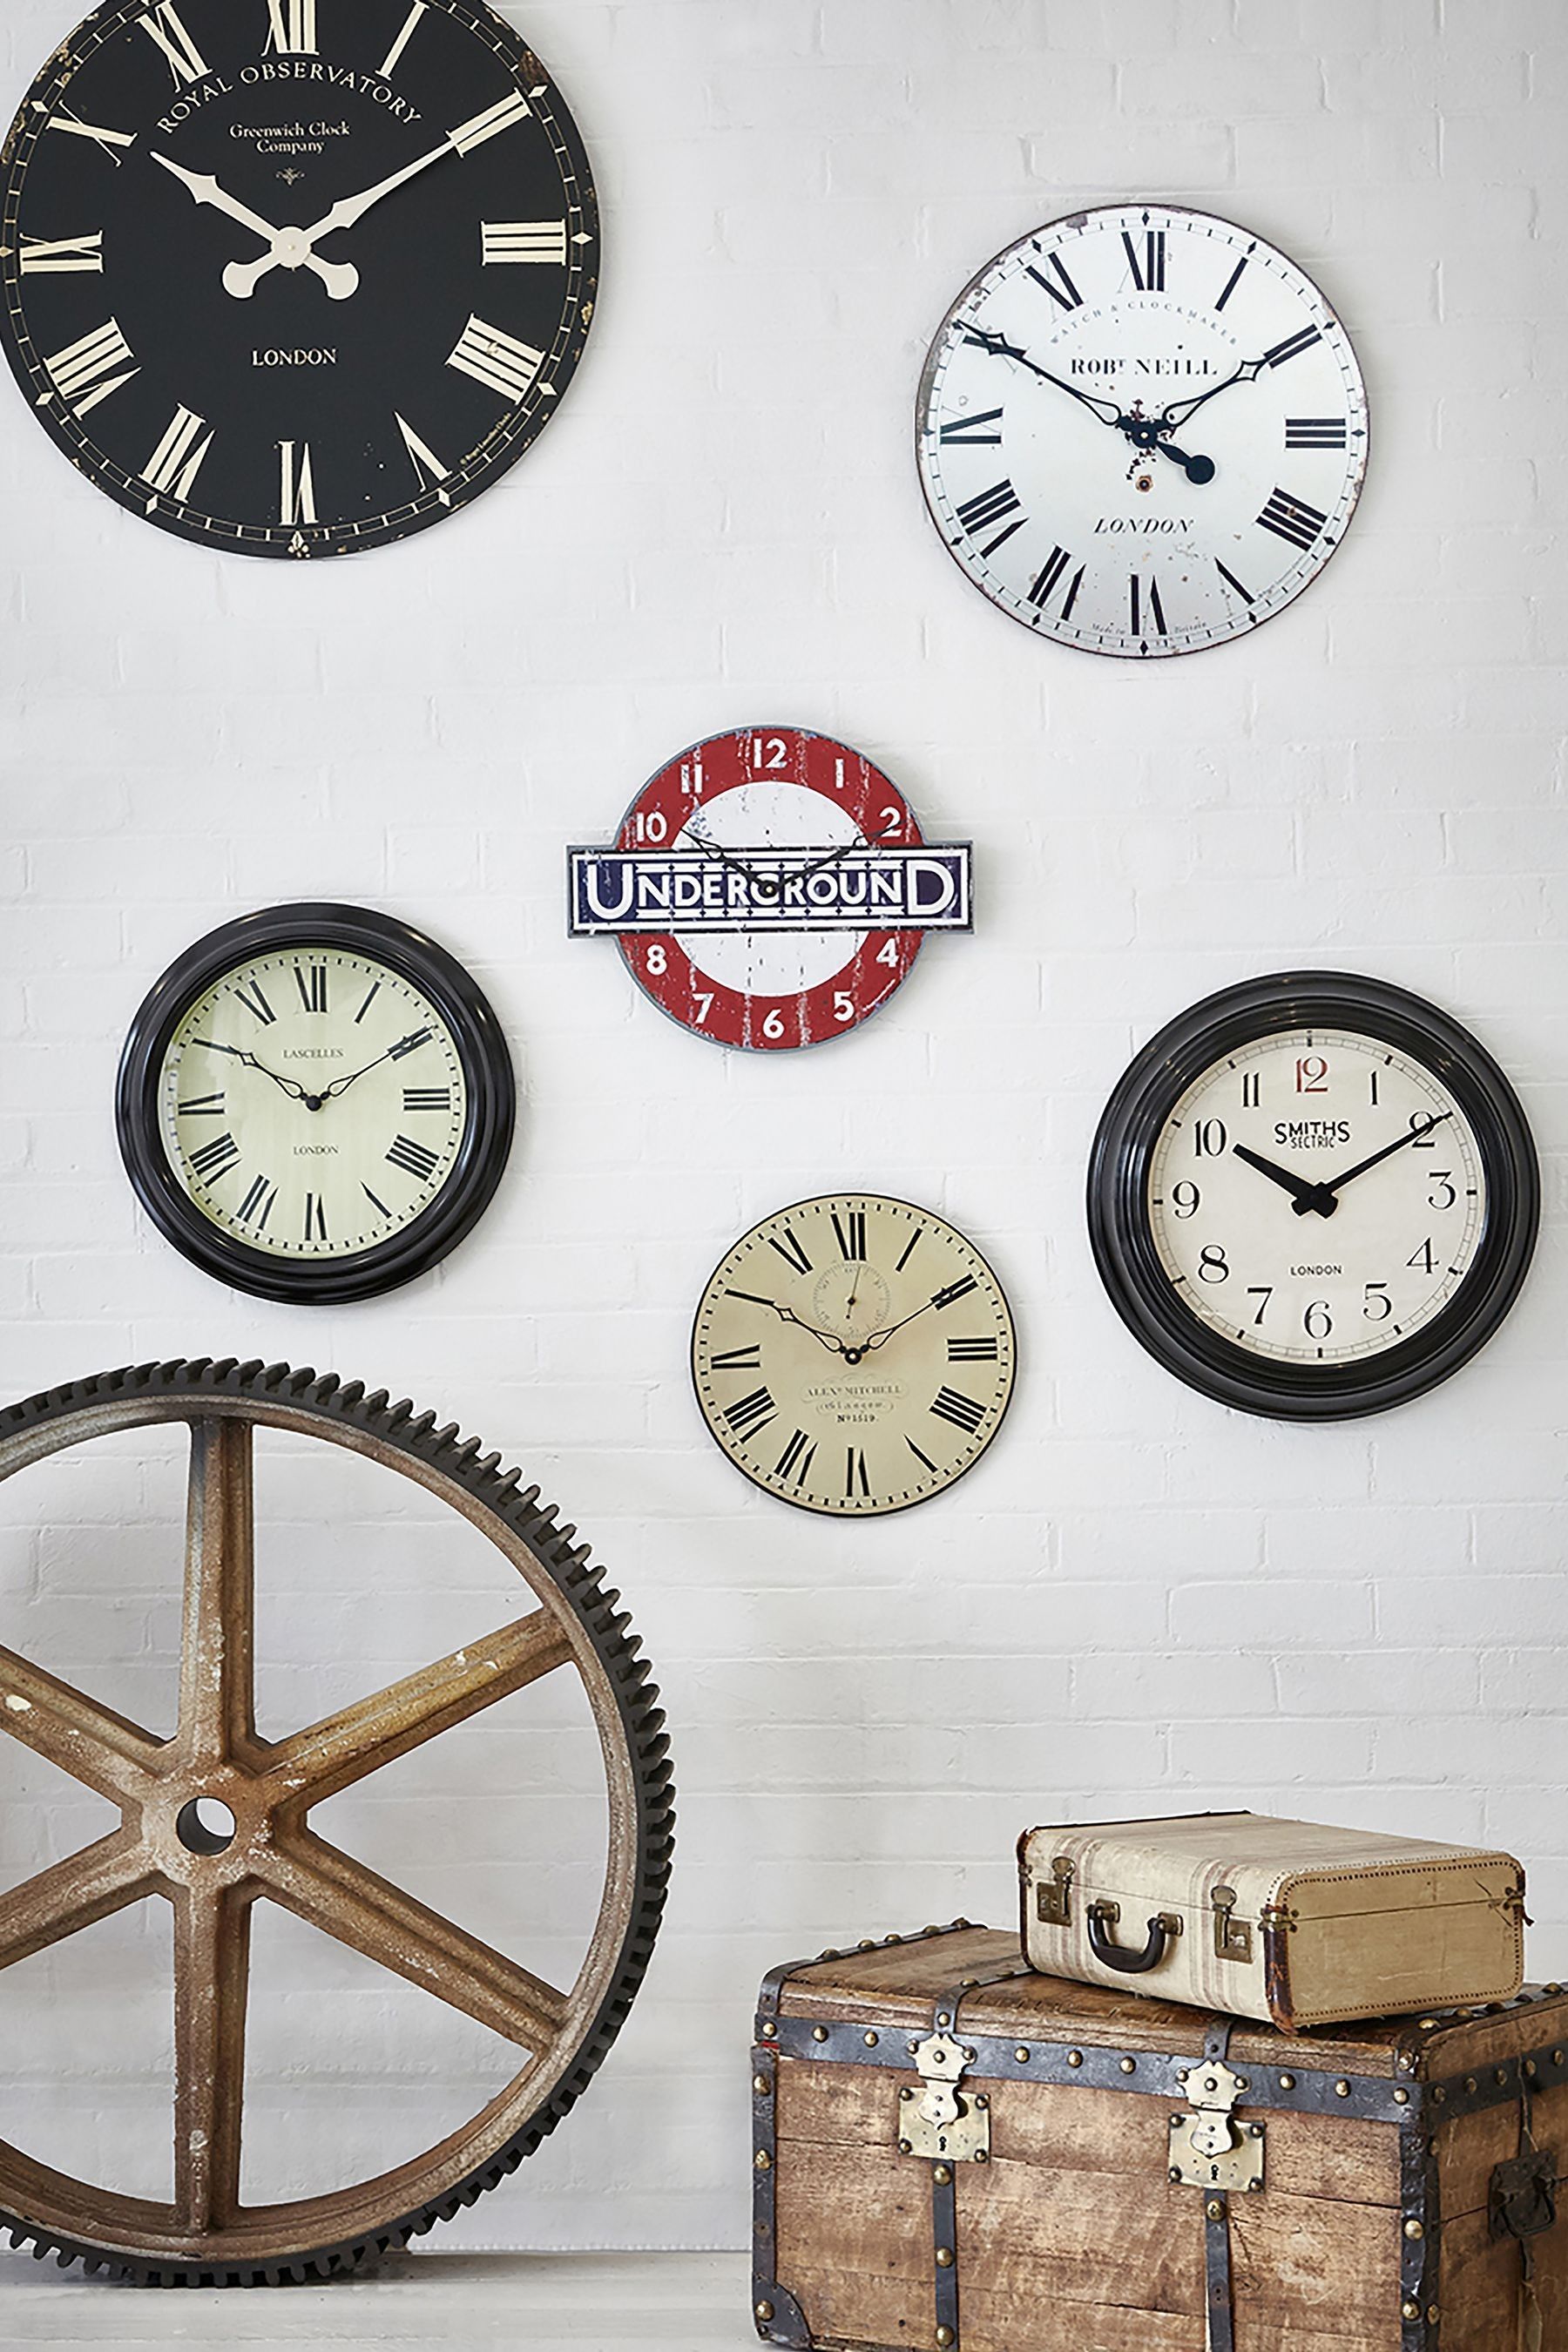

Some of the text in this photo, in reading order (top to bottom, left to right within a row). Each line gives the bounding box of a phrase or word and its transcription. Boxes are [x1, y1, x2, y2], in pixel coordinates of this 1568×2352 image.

[135, 0, 212, 91] XI
[157, 62, 422, 133] ROYAL OBSERVATORY
[45, 101, 138, 166] X
[229, 121, 350, 139] Greenwich Clock
[256, 139, 325, 155] Company
[19, 230, 103, 274] IX
[480, 220, 566, 265] III
[1119, 231, 1168, 294] XII
[1024, 250, 1085, 321] XI
[1214, 257, 1249, 311] I
[1128, 301, 1237, 346] CLOCKMAKER
[43, 316, 142, 420] VIII
[252, 348, 337, 366] LONDON
[445, 314, 544, 403] IIII
[1135, 359, 1217, 375] NEILL
[394, 411, 451, 491] V
[1285, 416, 1346, 449] III
[138, 403, 215, 503] VII
[279, 440, 318, 526] VI
[956, 478, 1029, 559] VIII
[1094, 518, 1194, 534] LONDON
[1254, 484, 1328, 551] IIII
[1026, 544, 1086, 620] VII
[1130, 574, 1167, 636] VI
[754, 740, 787, 768] 12
[681, 764, 702, 794] 11
[835, 760, 844, 787] 1
[636, 813, 667, 842] 10
[880, 808, 902, 836] 2
[587, 860, 956, 919] UNDERGROUND
[646, 945, 667, 975] 8
[876, 938, 898, 967] 4
[294, 966, 327, 1013] XII
[355, 981, 381, 1023] I
[693, 994, 713, 1023] 7
[834, 992, 854, 1021] 5
[763, 1010, 784, 1038] 6
[283, 1049, 344, 1059] LASCELLES
[1242, 1071, 1260, 1107] 11
[1294, 1056, 1328, 1092] 12
[1369, 1071, 1379, 1105] 1
[402, 1088, 450, 1111] III
[1193, 1119, 1227, 1157] 10
[1274, 1121, 1350, 1144] SMITHS
[1290, 1135, 1334, 1149] SECTRIC
[1409, 1111, 1436, 1148] 2
[189, 1132, 242, 1188] VIII
[293, 1146, 339, 1155] LONDON
[384, 1134, 440, 1181] IIII
[236, 1175, 279, 1230] VII
[1173, 1181, 1200, 1219] 9
[1428, 1172, 1456, 1210] 3
[304, 1193, 327, 1241] VI
[830, 1213, 867, 1261] XII
[895, 1228, 923, 1273] I
[1407, 1238, 1438, 1274] 4
[1199, 1245, 1229, 1283] 8
[1290, 1265, 1342, 1275] LONDON
[1247, 1287, 1274, 1324] 7
[1305, 1301, 1333, 1339] 6
[1363, 1283, 1393, 1321] 5
[947, 1337, 997, 1362] III
[845, 1385, 900, 1395] MITCHELL
[723, 1385, 780, 1444] VIII
[929, 1385, 988, 1435] IIII
[774, 1429, 819, 1486] VII
[846, 1447, 869, 1497] VI
